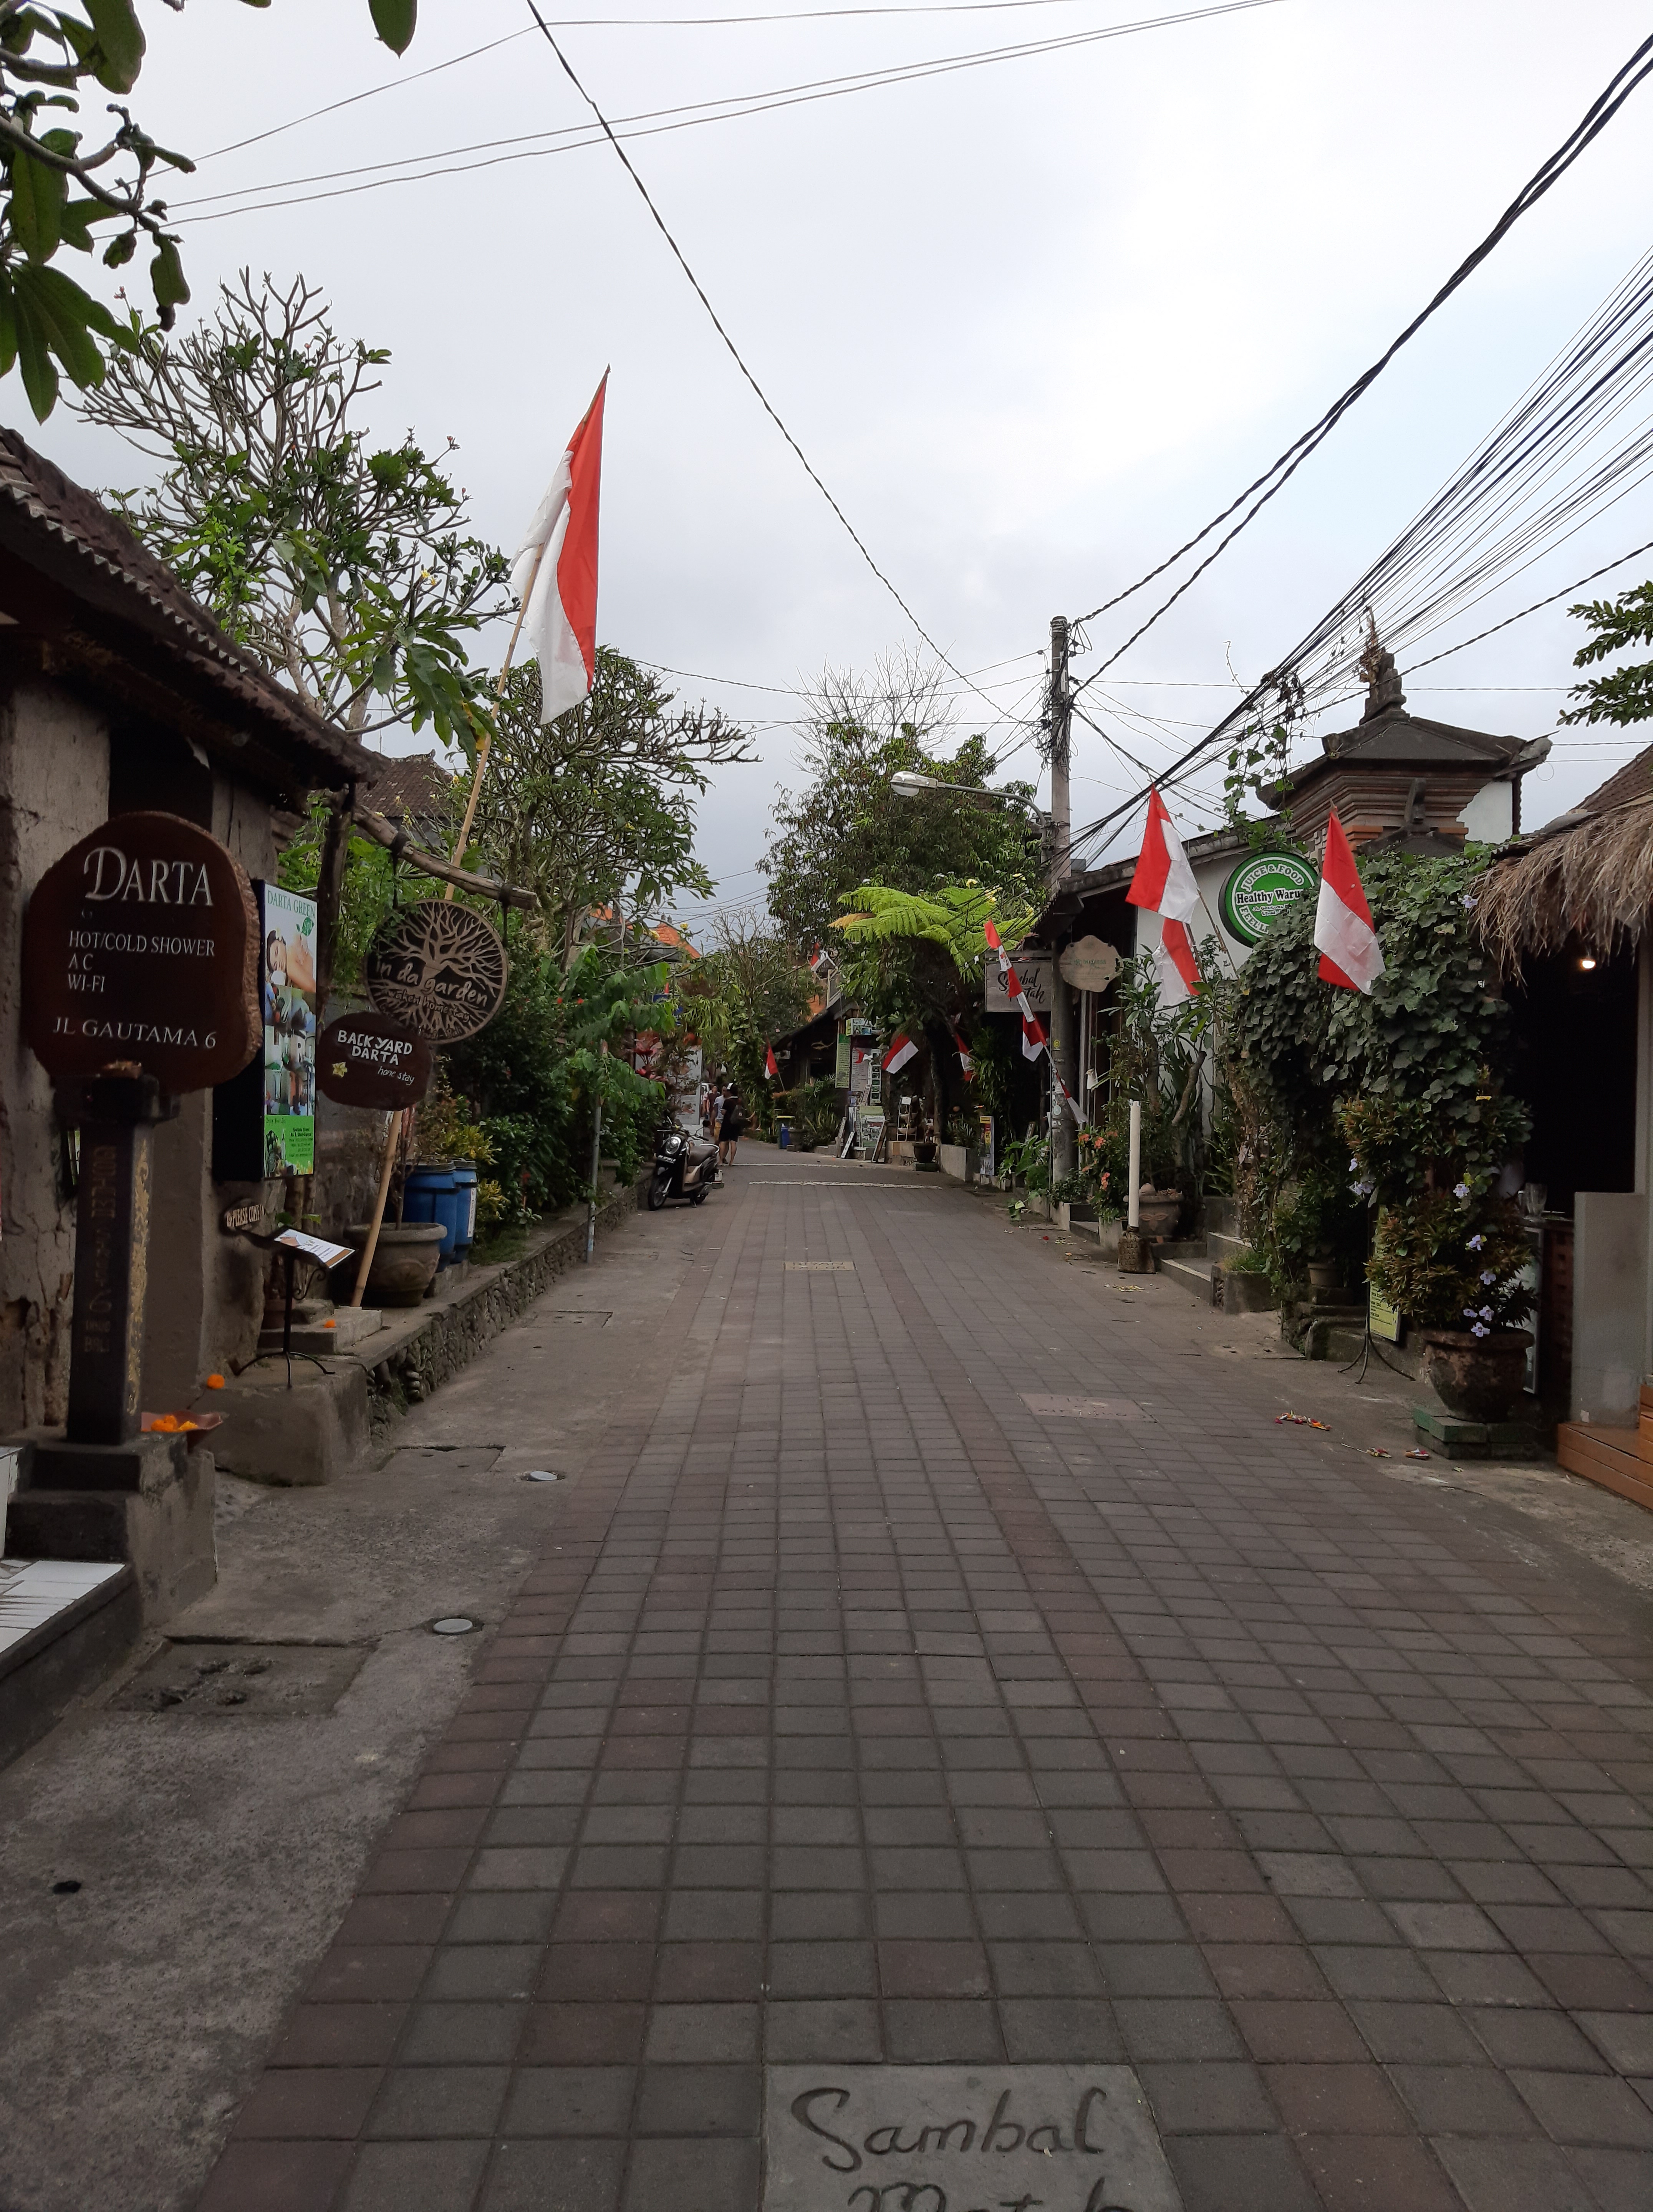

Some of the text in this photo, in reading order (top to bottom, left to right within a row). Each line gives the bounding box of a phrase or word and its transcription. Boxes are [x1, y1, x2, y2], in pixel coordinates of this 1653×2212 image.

[84, 847, 214, 906] DARTA
[1243, 867, 1266, 890] JUICE
[1279, 866, 1303, 884] FOOD
[268, 890, 315, 918] DARTA GREEN
[1237, 889, 1302, 903] Healthy Waru
[1241, 907, 1258, 928] FEEL
[69, 931, 214, 957] HOT/COLD SHOWER
[68, 974, 105, 992] WI-FI
[397, 962, 419, 985] da
[421, 978, 488, 1007] garden
[53, 1017, 217, 1048] JL GAUTAMA 6
[352, 1046, 399, 1065] DARTA
[378, 1066, 415, 1086] home stay
[232, 1207, 248, 1227] PLEASE
[249, 1205, 260, 1223] COME
[791, 2087, 1107, 2172] Sambal
